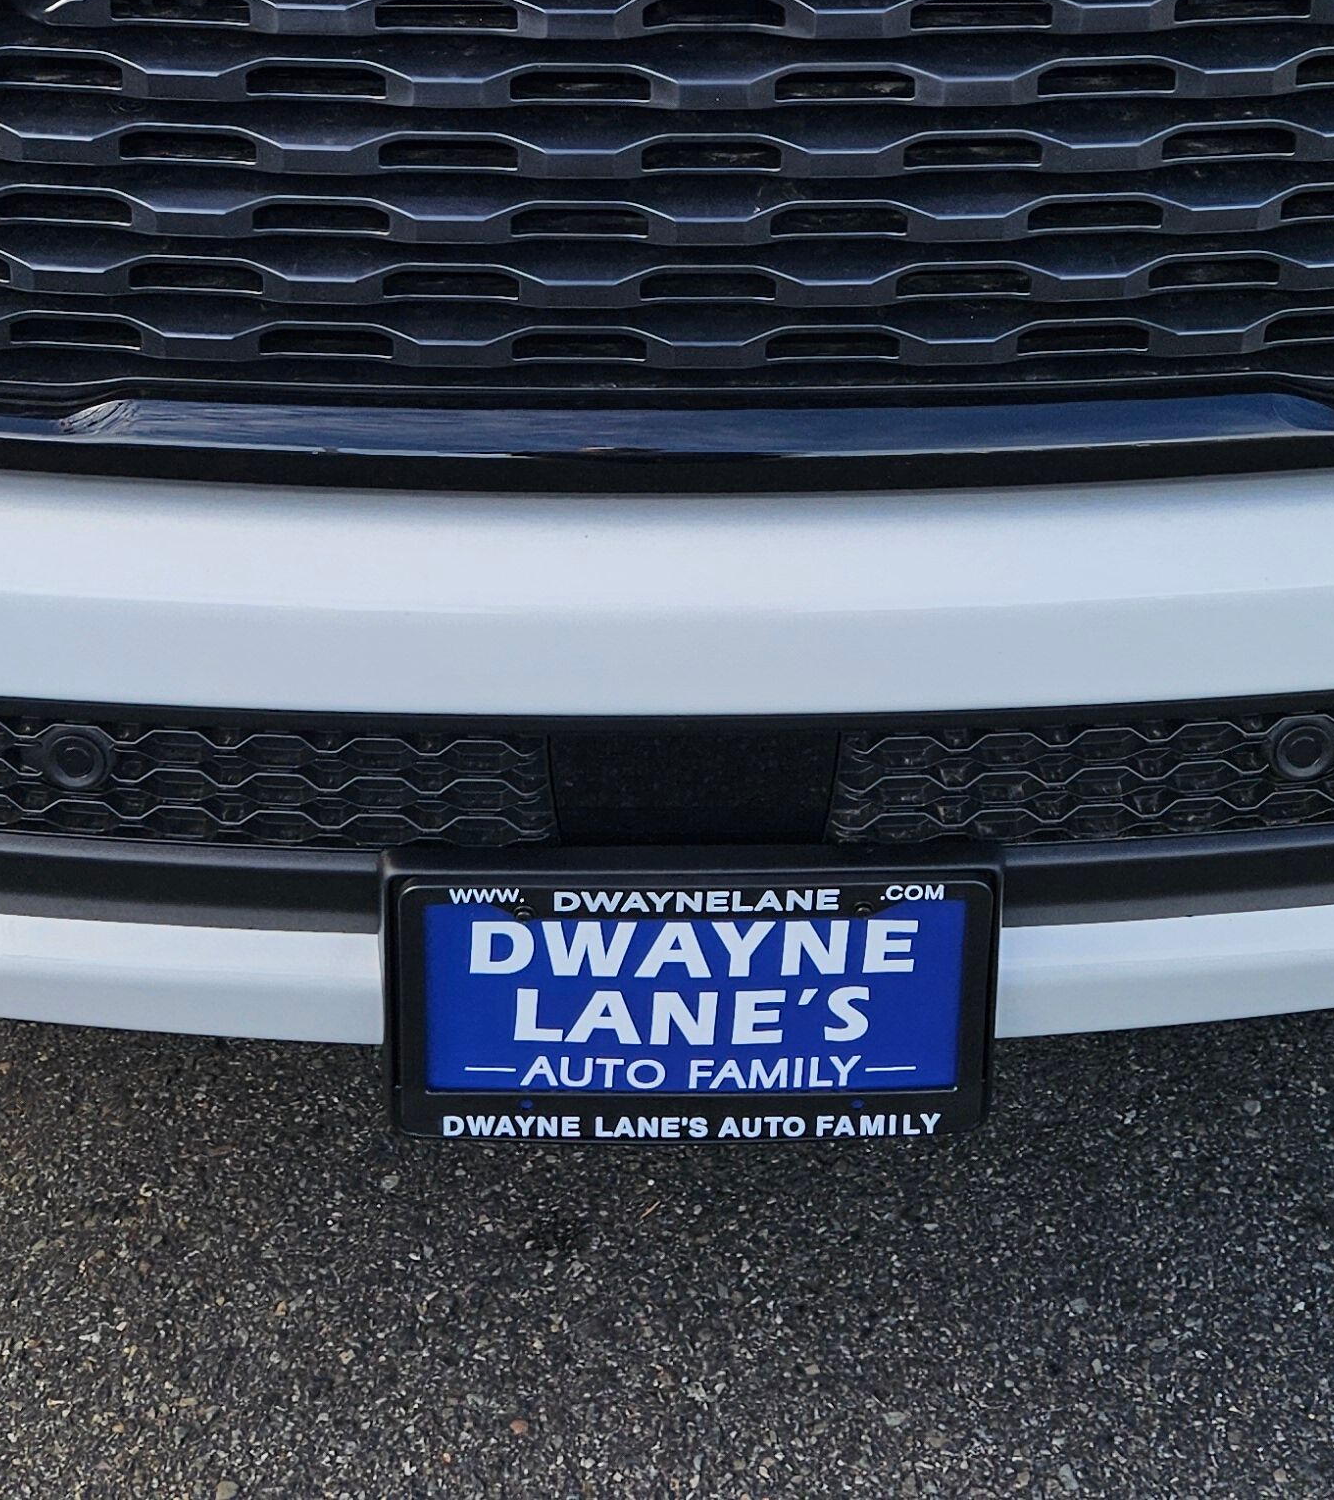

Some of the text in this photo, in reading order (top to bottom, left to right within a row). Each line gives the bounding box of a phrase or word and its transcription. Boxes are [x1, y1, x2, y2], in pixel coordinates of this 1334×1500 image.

[553, 888, 841, 913] DWAYNELANE
[879, 884, 946, 902] .COM
[469, 919, 920, 978] DWAYNE
[513, 986, 870, 1046] LANE'S
[520, 1055, 862, 1089] AUTO FAMILY
[442, 1112, 942, 1138] DWAYNE LANE'S AUTO FAMILY
